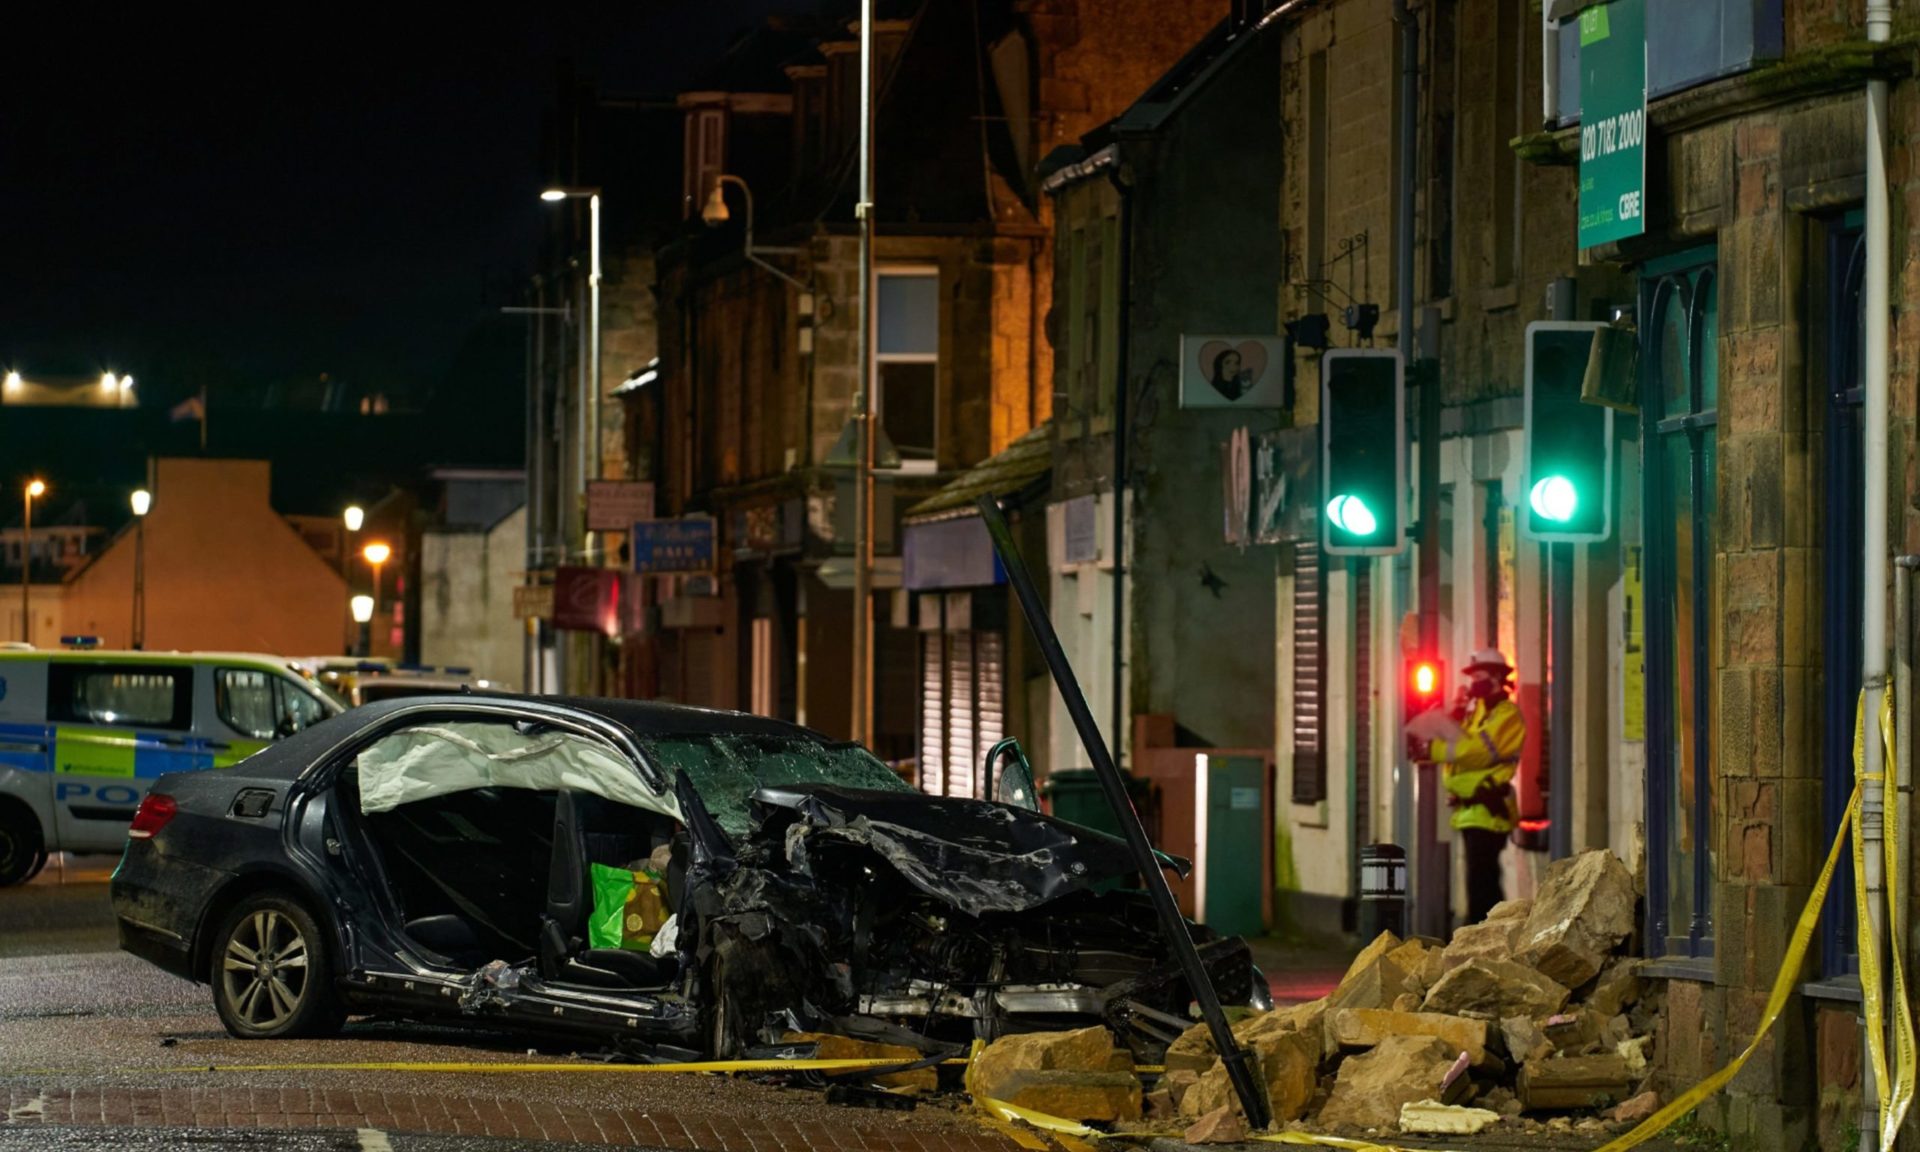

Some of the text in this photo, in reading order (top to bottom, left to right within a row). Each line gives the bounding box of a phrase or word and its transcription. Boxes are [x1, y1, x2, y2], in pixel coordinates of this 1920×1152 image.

[1582, 108, 1642, 163] 020 7182 2000
[1618, 190, 1640, 221] CBRE
